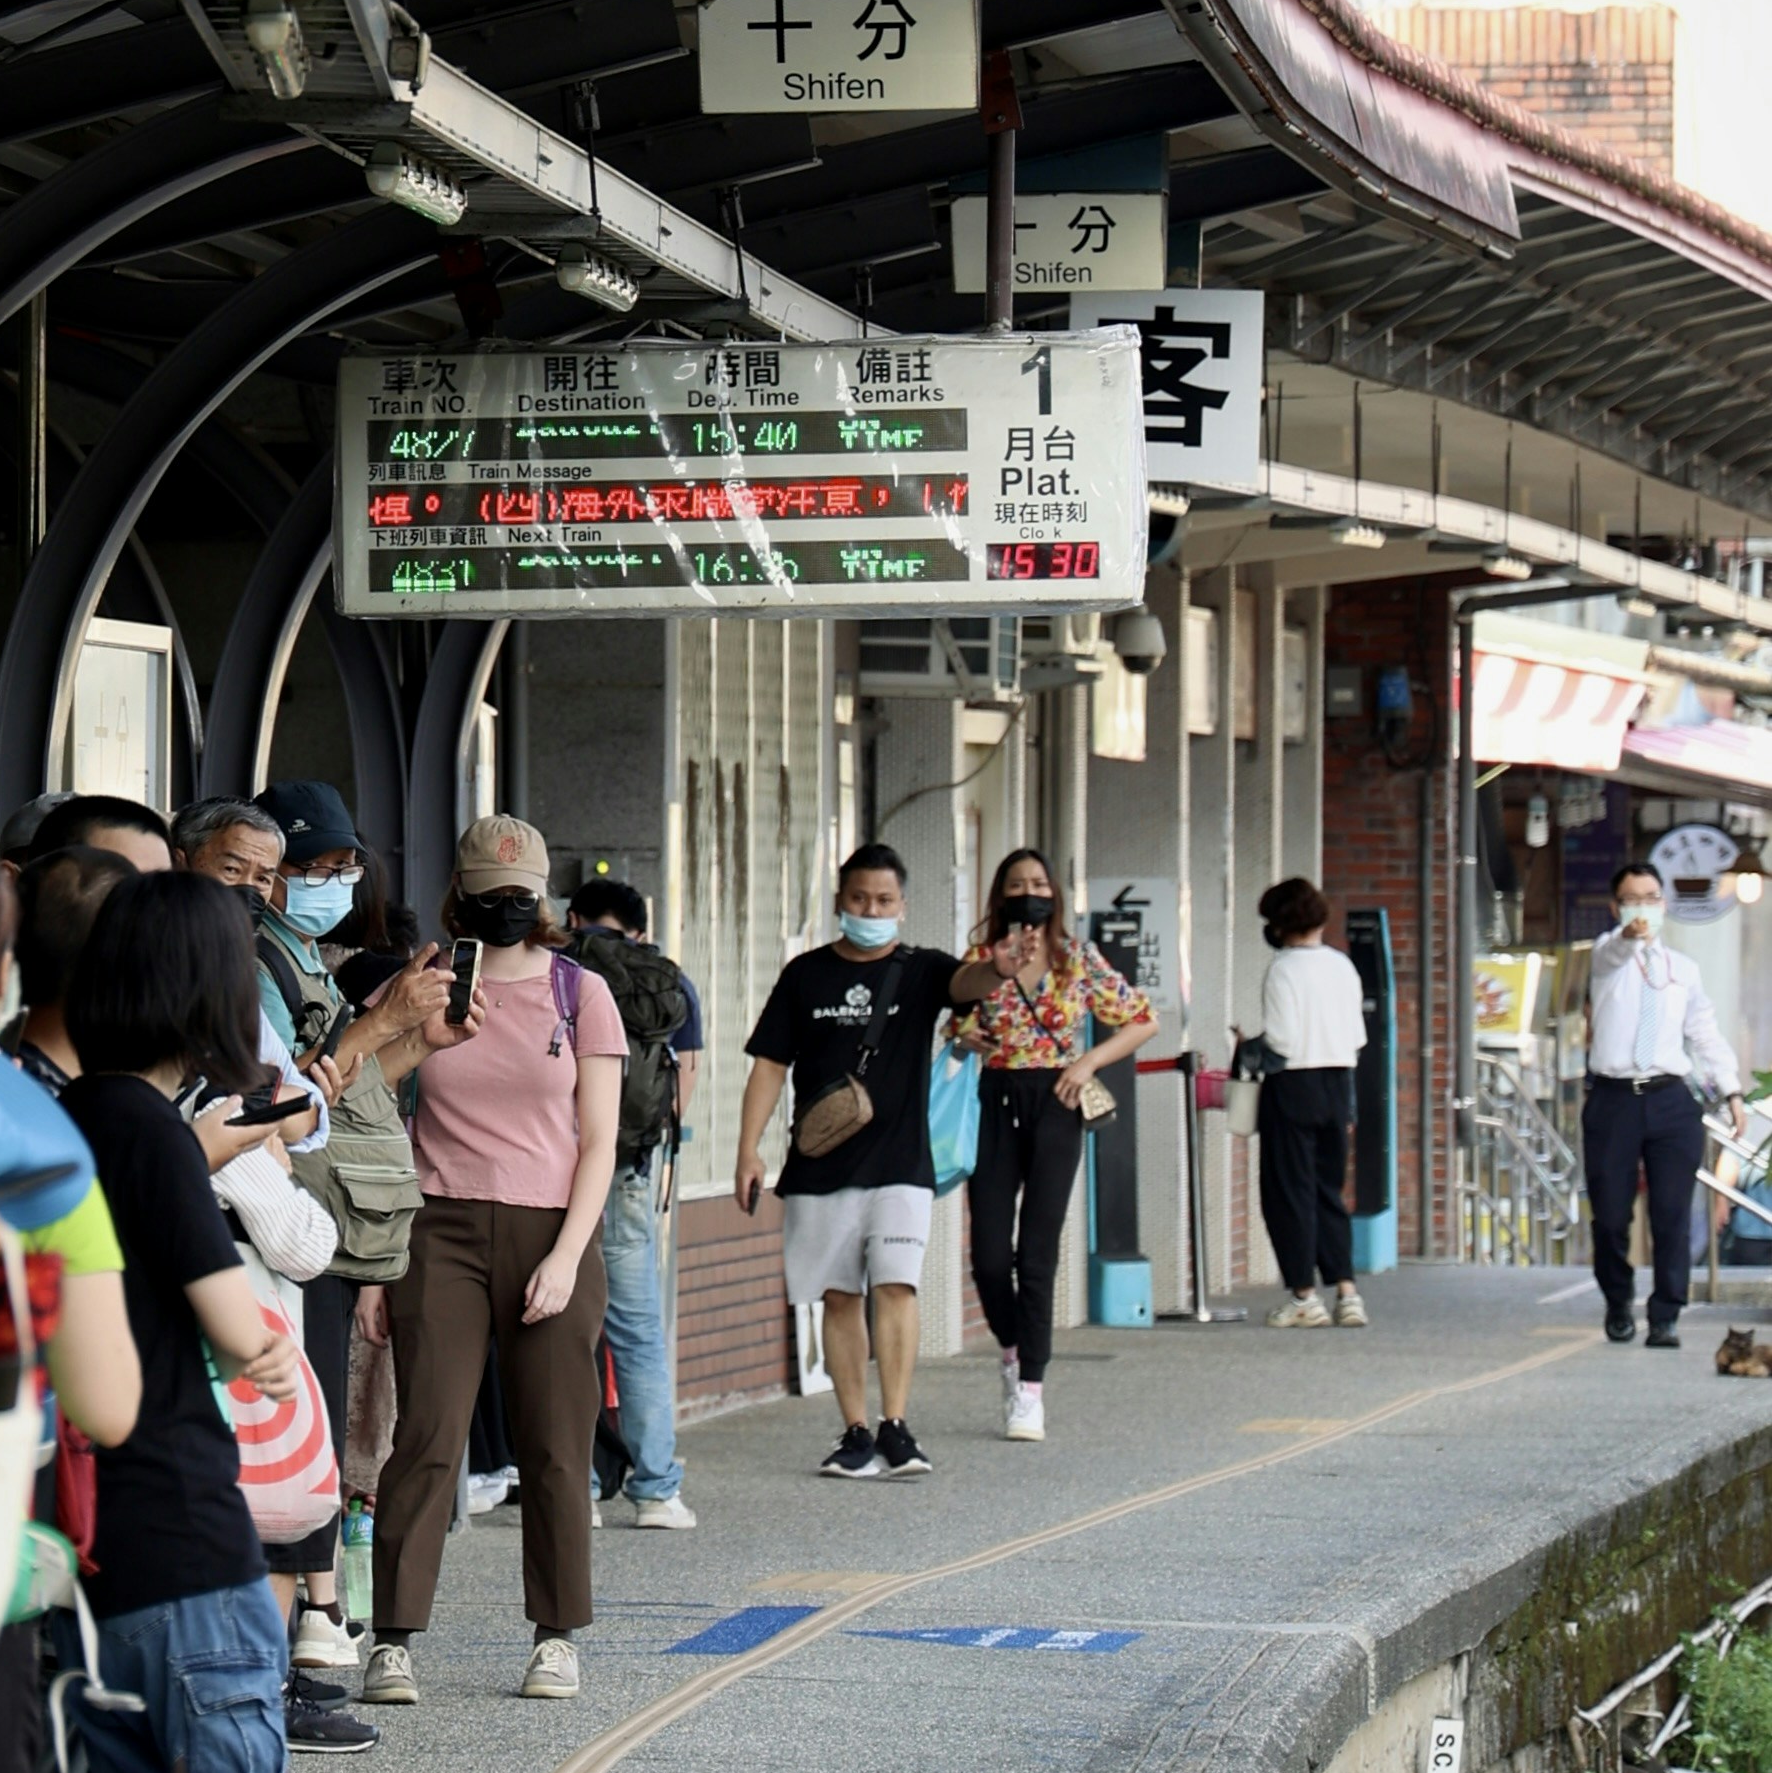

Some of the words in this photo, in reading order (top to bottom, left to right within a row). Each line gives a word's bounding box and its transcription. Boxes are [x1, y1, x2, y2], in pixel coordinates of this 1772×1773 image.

[783, 71, 885, 102] Shifen
[1015, 262, 1092, 284] Shifen
[382, 358, 458, 394] 車次
[544, 355, 620, 393] 開往
[704, 350, 780, 388] 時間
[855, 347, 932, 385] 備註
[1098, 305, 1231, 448] 客
[1021, 345, 1052, 416] 1
[368, 395, 423, 415] Train
[432, 395, 472, 414] NO.
[518, 392, 646, 413] Destination
[748, 388, 800, 406] Time
[849, 385, 945, 404] Remarks
[1004, 425, 1076, 462] 月台
[368, 463, 447, 482] 列車訊息
[467, 463, 511, 479] Train
[516, 462, 593, 480] Message
[1000, 466, 1080, 496] Plat.
[994, 501, 1088, 524] 現在時刻
[369, 527, 488, 548] 下班列車資訊
[508, 527, 553, 543] Next
[561, 526, 602, 543] Train
[1019, 525, 1063, 540] Clok
